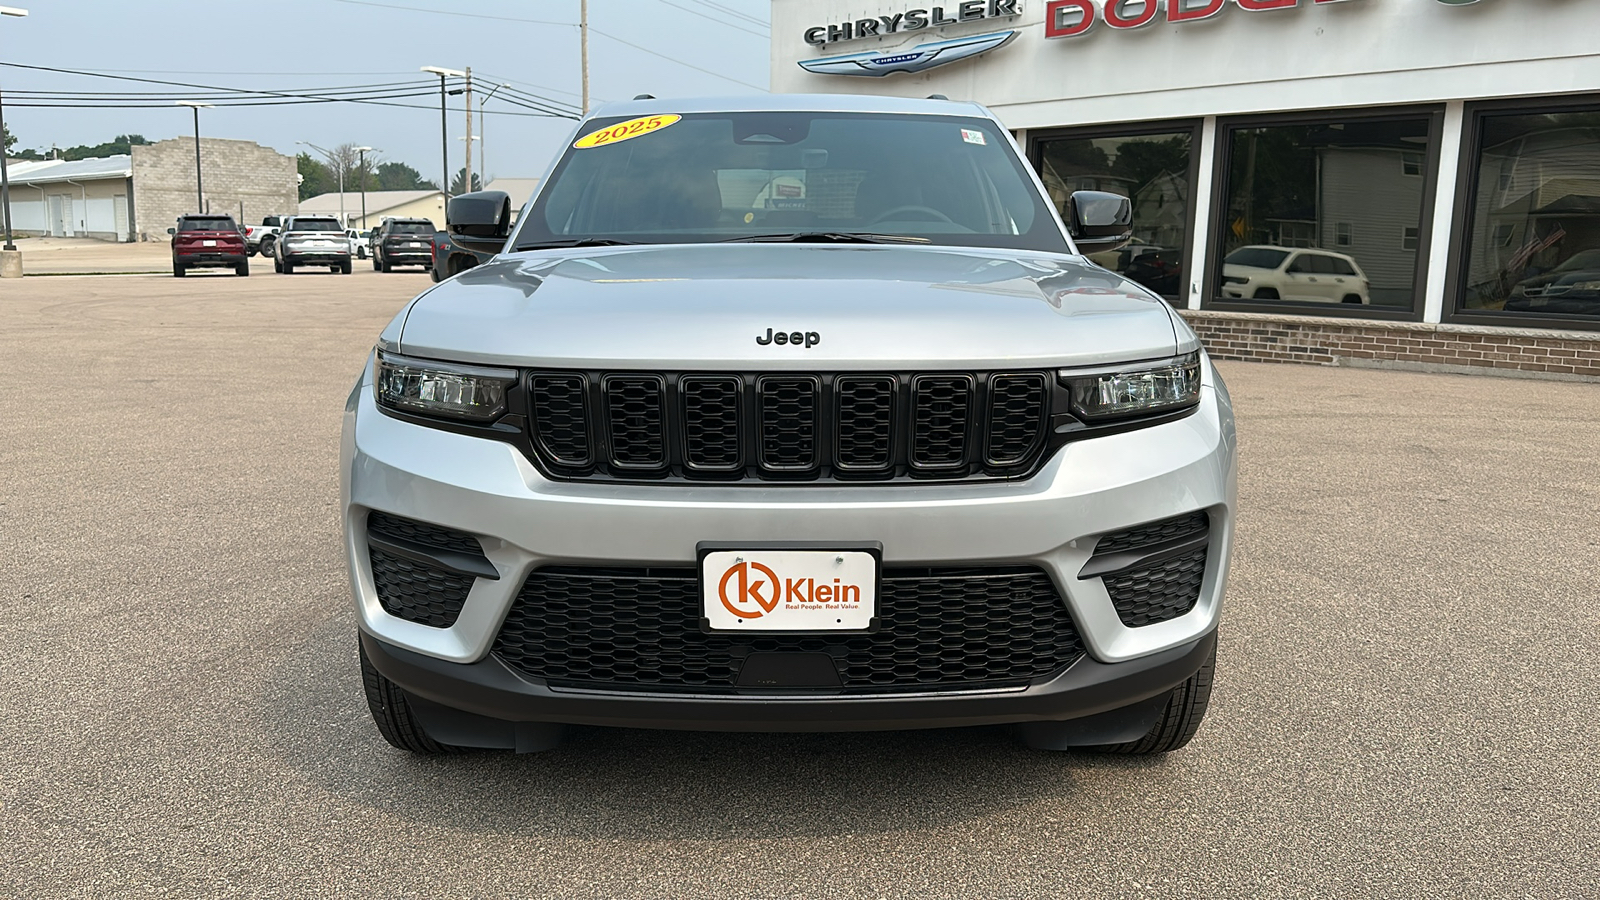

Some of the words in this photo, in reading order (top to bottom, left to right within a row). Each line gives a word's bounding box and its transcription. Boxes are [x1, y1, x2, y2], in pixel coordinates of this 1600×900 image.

[804, 0, 1018, 46] CHRYSLER
[875, 54, 918, 64] CHRYSLER
[594, 117, 662, 144] 2025
[756, 327, 820, 348] Jeep
[785, 578, 860, 602] Klein
